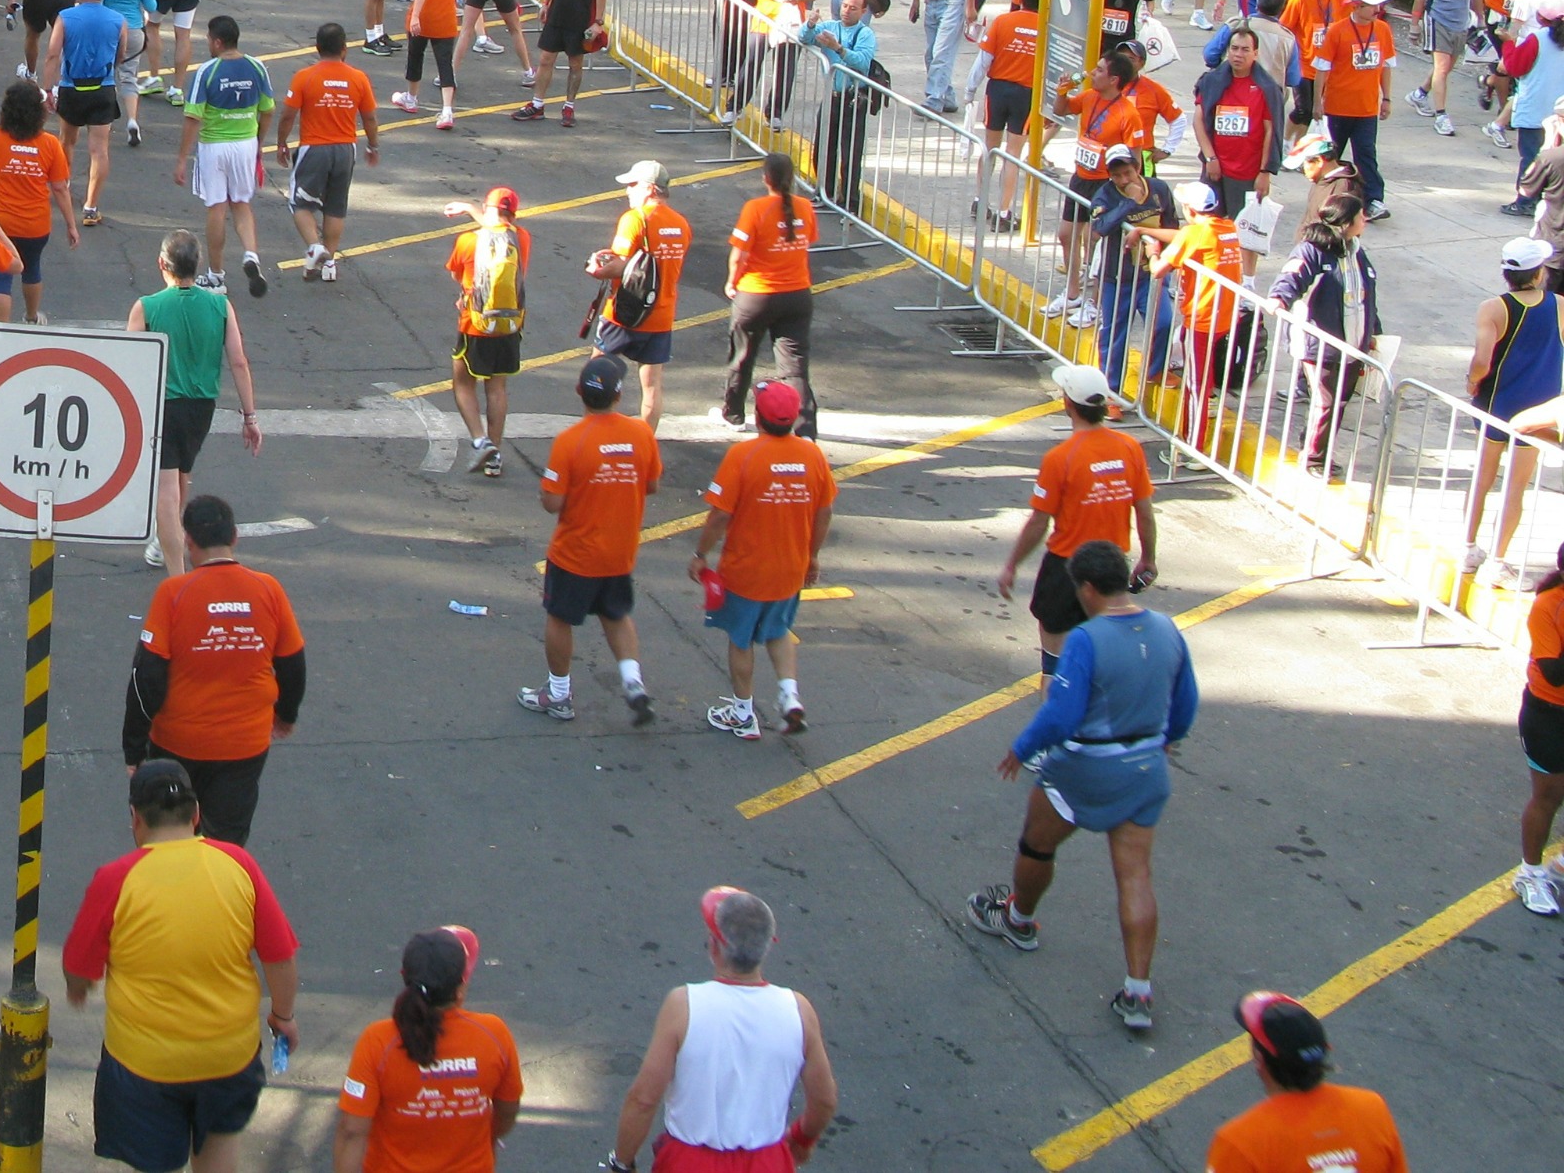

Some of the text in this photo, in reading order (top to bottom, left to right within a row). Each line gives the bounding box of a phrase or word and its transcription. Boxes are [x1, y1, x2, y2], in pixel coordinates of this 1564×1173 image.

[1101, 17, 1126, 32] 2610
[1353, 52, 1378, 65] 342
[1216, 117, 1247, 131] 5267
[10, 145, 38, 154] CORRE
[23, 393, 89, 452] 10
[599, 443, 634, 454] CORRE
[770, 463, 806, 473] CORRE
[207, 602, 251, 613] CORRE
